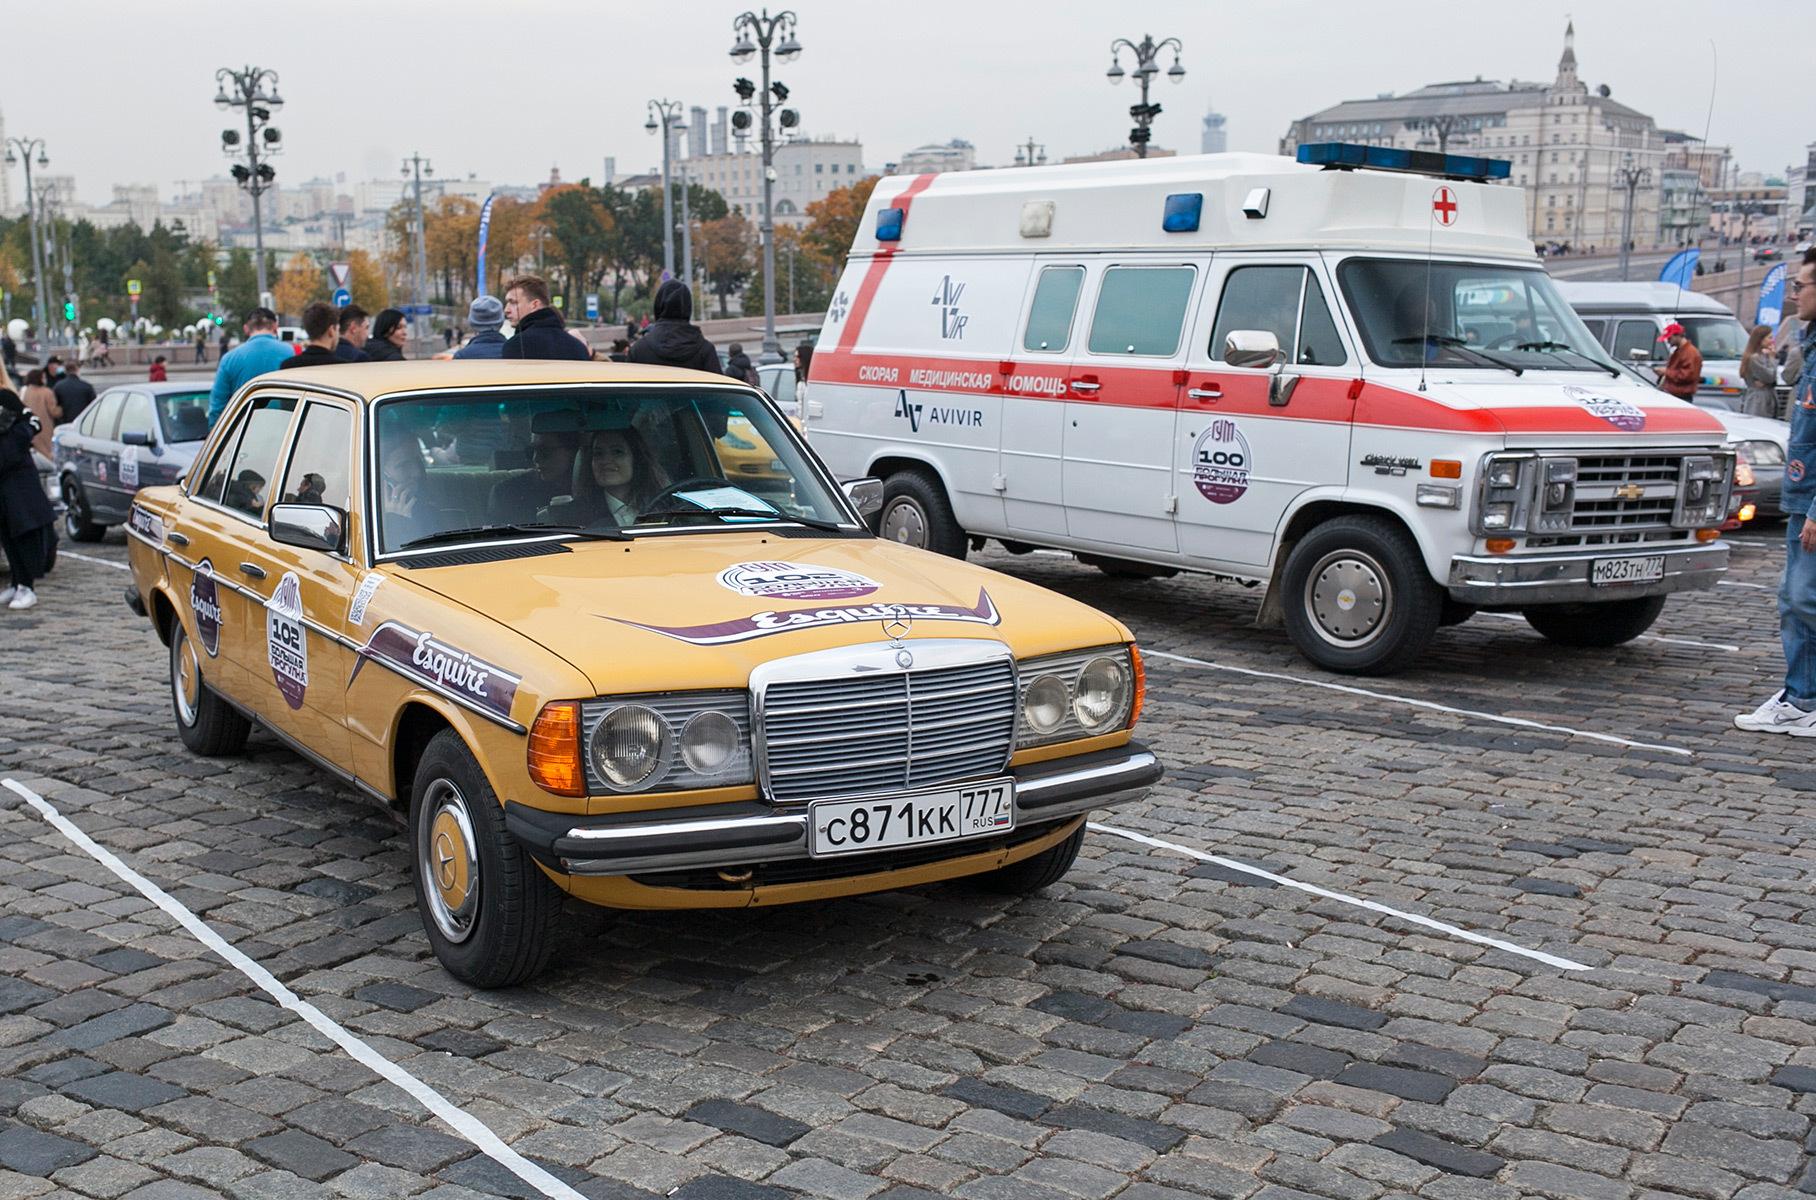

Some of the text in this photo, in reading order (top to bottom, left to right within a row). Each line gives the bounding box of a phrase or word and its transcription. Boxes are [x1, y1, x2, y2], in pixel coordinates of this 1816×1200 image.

[858, 365, 899, 383] СКОРАЯ
[909, 368, 992, 390] МЕДИЦИНСКАЯ
[929, 407, 982, 427] AVIVIR
[1211, 419, 1236, 443] ГУМ
[1199, 450, 1244, 467] 100
[743, 573, 842, 585] 102
[191, 584, 223, 625] Esquire
[273, 618, 301, 651] 102
[412, 632, 489, 697] Esquire
[962, 787, 1004, 820] 777
[972, 816, 994, 829] RUS
